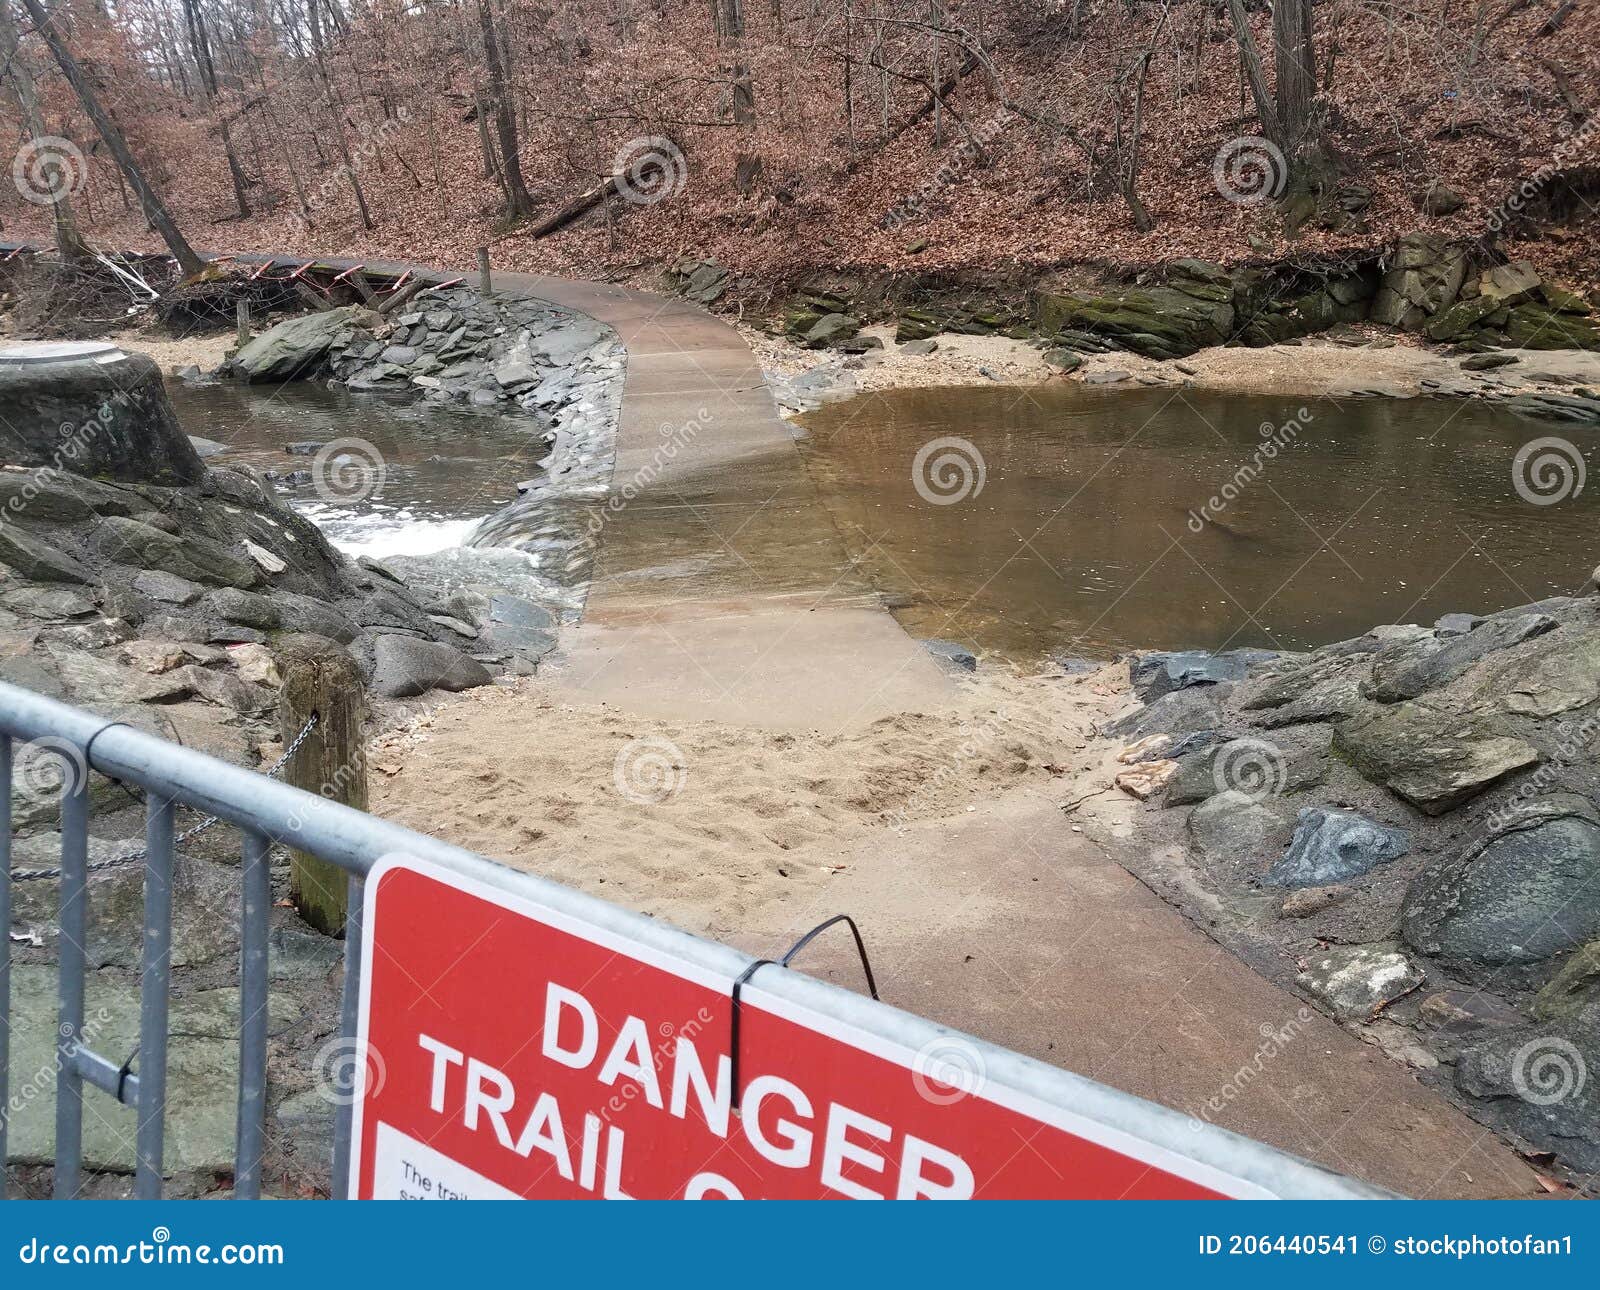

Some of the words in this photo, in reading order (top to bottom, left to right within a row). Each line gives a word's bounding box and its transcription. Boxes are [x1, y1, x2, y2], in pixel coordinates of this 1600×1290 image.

[418, 1033, 638, 1200] TRAIL
[542, 981, 975, 1200] DANGER
[401, 1159, 432, 1192] The
